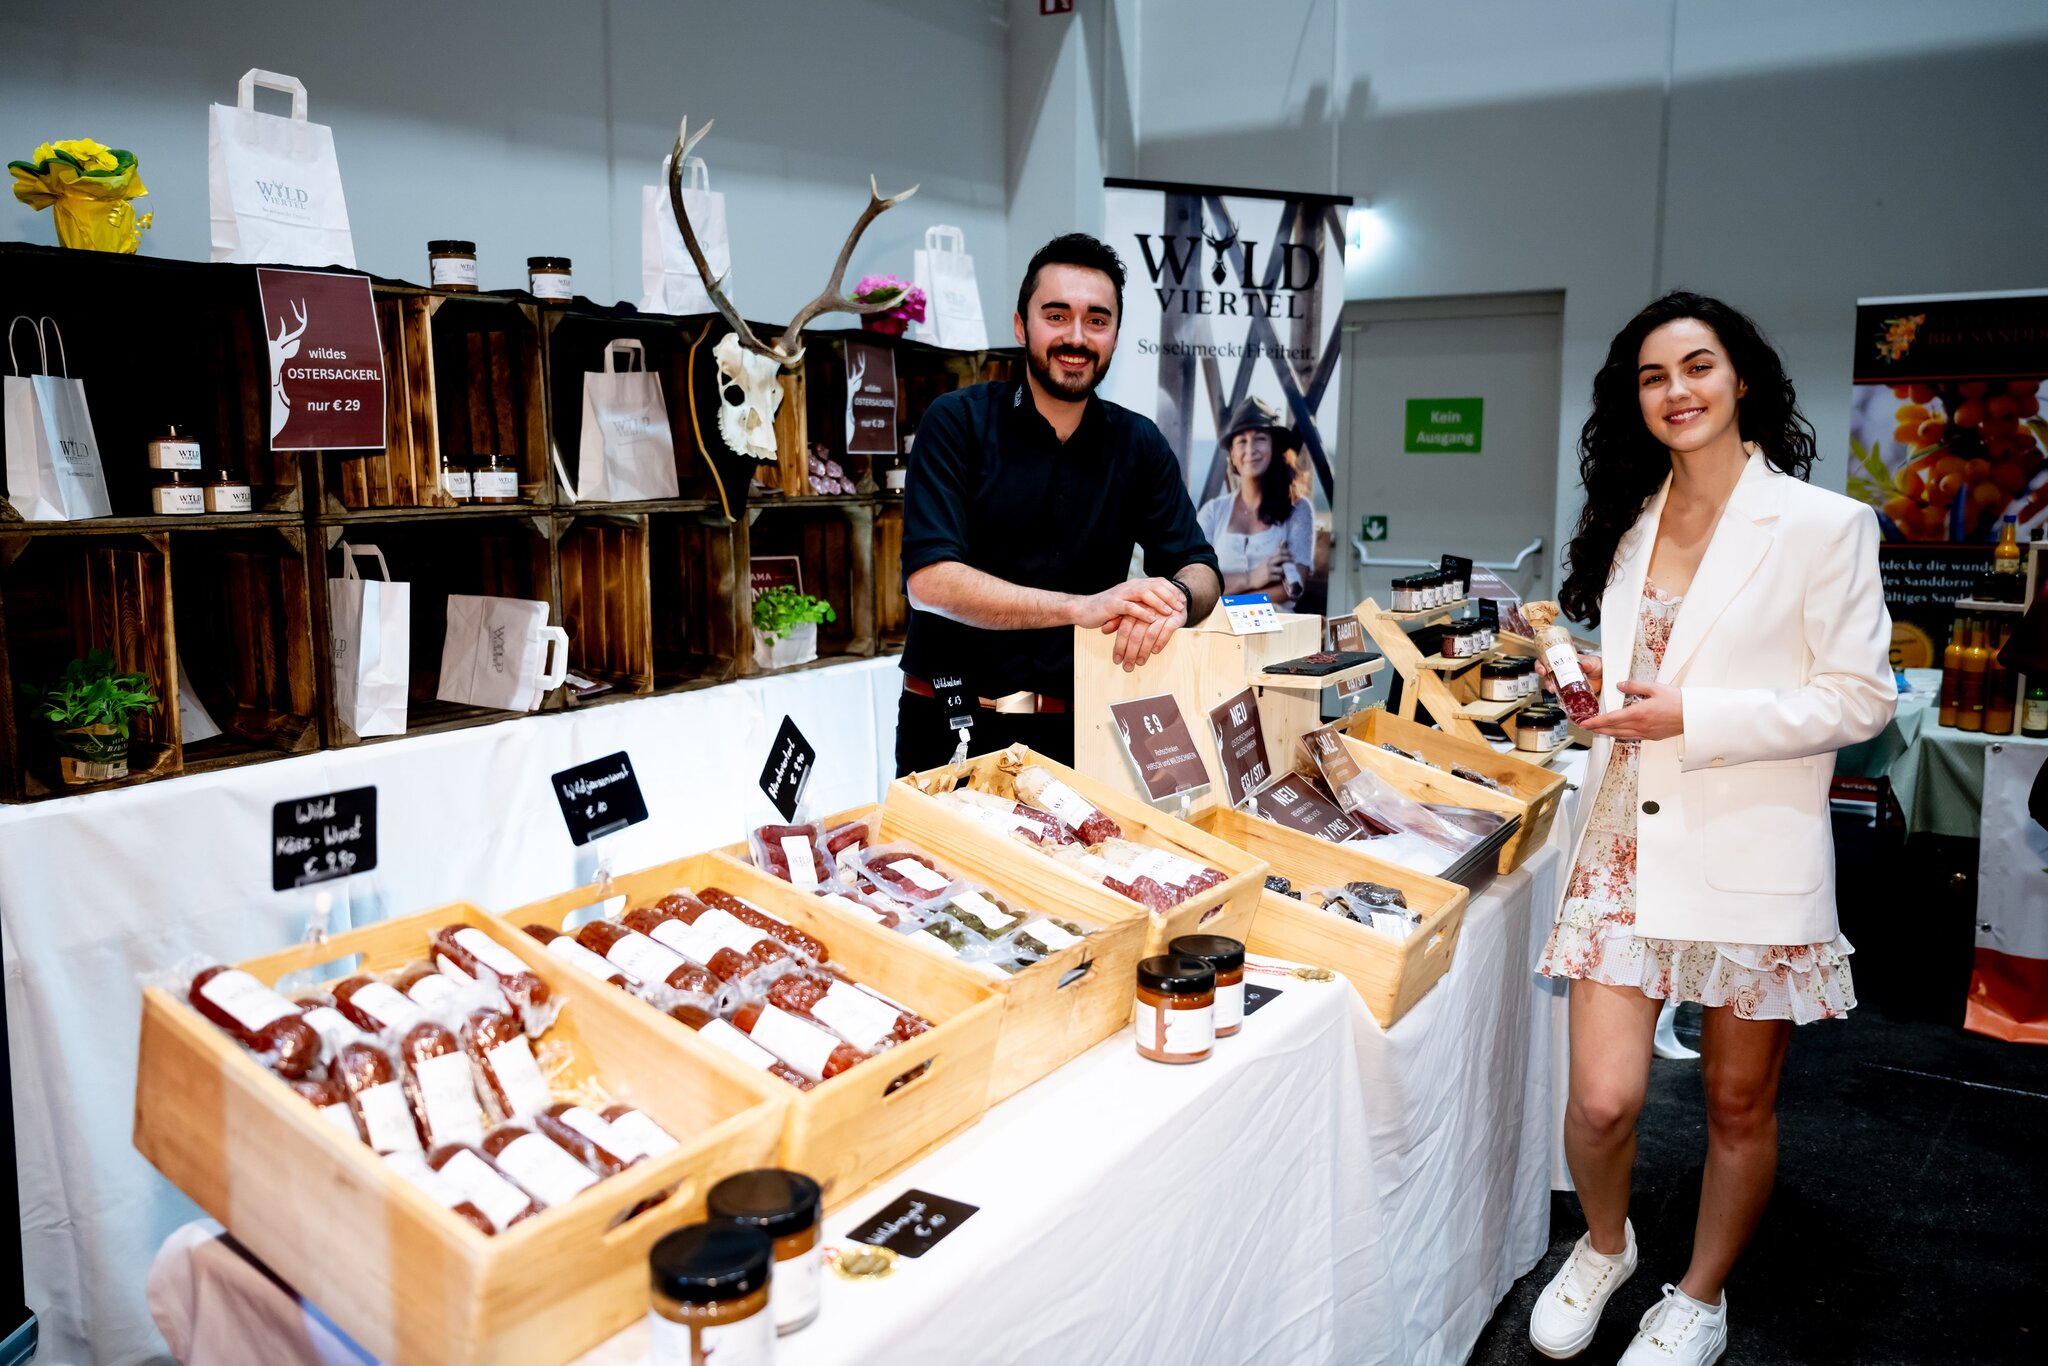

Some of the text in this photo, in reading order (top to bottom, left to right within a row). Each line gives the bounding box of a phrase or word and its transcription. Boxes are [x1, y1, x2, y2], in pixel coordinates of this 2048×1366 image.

[1134, 230, 1320, 291] WILD
[1154, 288, 1305, 319] VIERTEL
[308, 347, 347, 360] wildes
[1137, 339, 1158, 355] So
[1162, 340, 1243, 358] schmeckt
[287, 368, 381, 381] OSTERSACKERL
[307, 400, 361, 412] nur € 29
[1430, 410, 1462, 424] Kein
[1416, 431, 1475, 447] Ausgang
[178, 449, 200, 457] WILD
[179, 494, 202, 502] WILD
[1880, 559, 1923, 571] tdecke
[1926, 559, 1947, 571] die
[1337, 621, 1358, 641] RABATT
[1229, 701, 1248, 728] NEU
[1154, 745, 1180, 757] Rohschinken
[1146, 760, 1163, 771] HIRSCH
[1170, 751, 1197, 766] WILDSCHWEIN
[1253, 761, 1266, 782] STK
[1270, 785, 1299, 807] NEU
[295, 796, 337, 824] Wild
[1327, 818, 1350, 837] PKG
